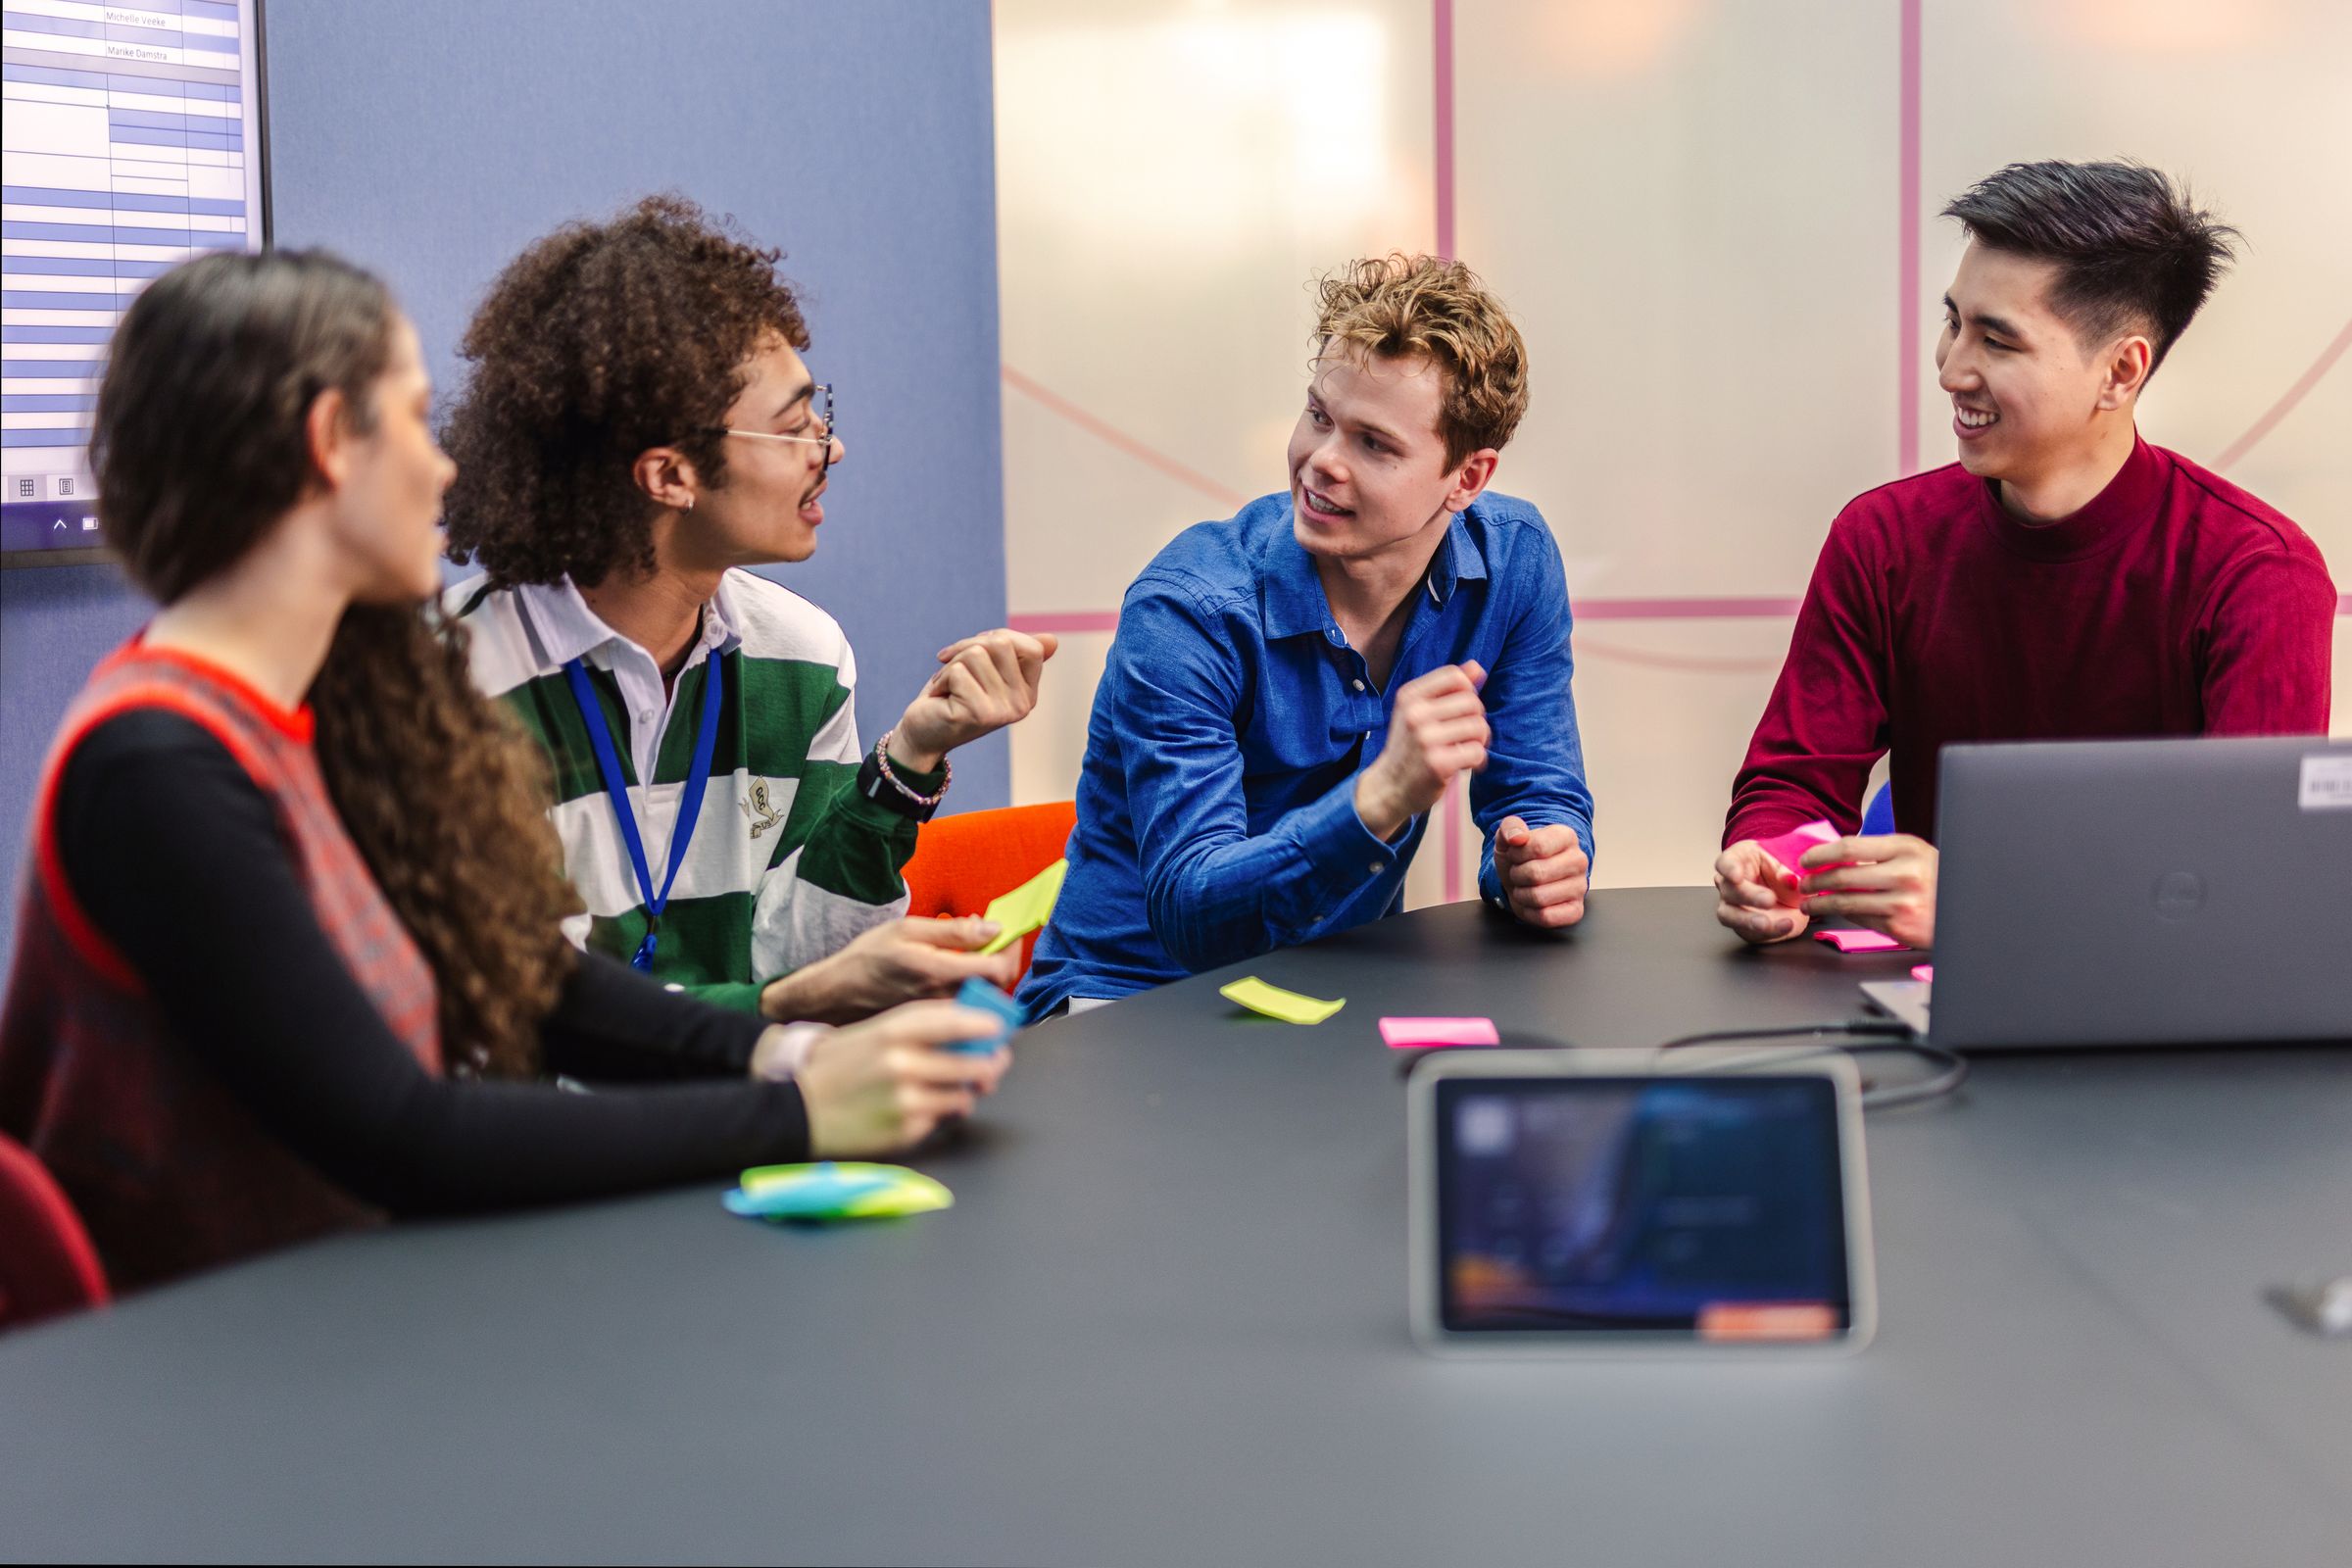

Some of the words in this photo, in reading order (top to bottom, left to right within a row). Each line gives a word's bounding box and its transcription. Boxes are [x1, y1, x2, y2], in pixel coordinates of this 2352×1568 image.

[106, 12, 140, 24] Michelle
[142, 17, 166, 27] Veeke
[107, 46, 135, 58] Marike
[136, 49, 168, 61] Damstra
